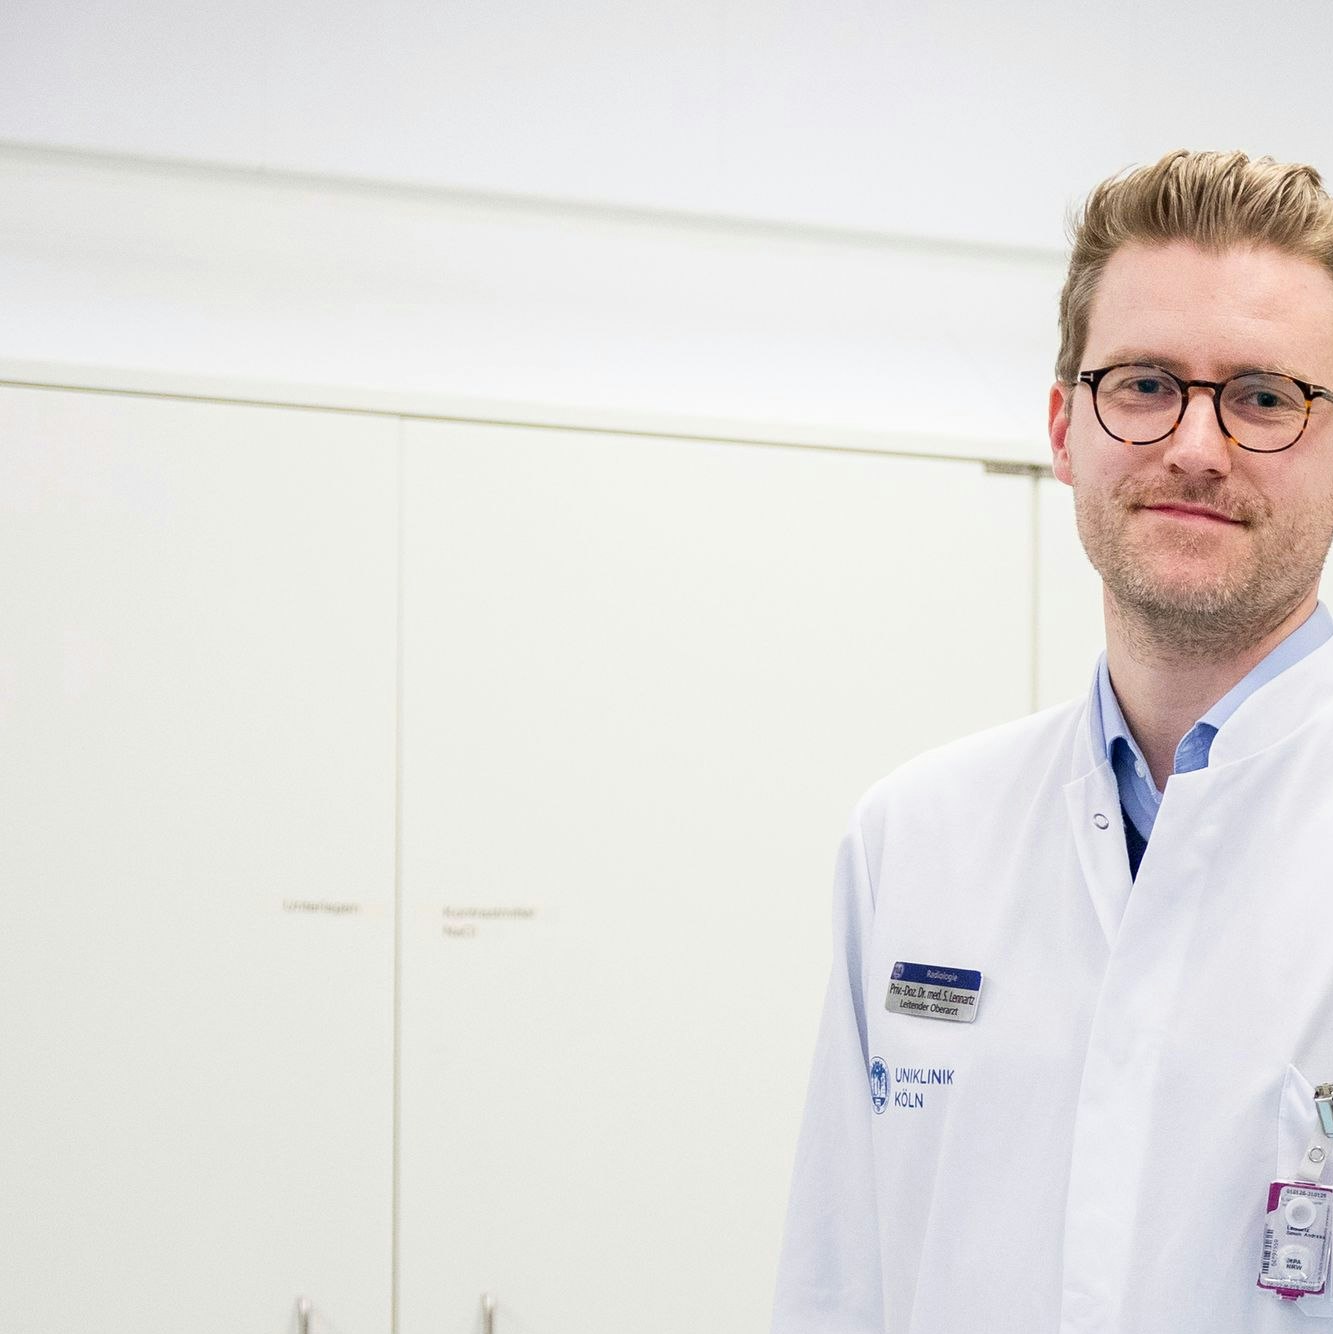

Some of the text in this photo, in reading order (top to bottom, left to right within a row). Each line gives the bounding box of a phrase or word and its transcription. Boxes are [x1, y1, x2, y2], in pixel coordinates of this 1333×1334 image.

[926, 969, 958, 983] Radiologie
[917, 986, 927, 999] Dr.
[928, 989, 942, 1001] med.
[943, 990, 948, 1001] S.
[949, 991, 976, 1006] Lennartz
[899, 999, 959, 1016] Leitender Oberarzt
[895, 1067, 955, 1085] UNIKLINIK
[894, 1088, 924, 1108] KÖLN
